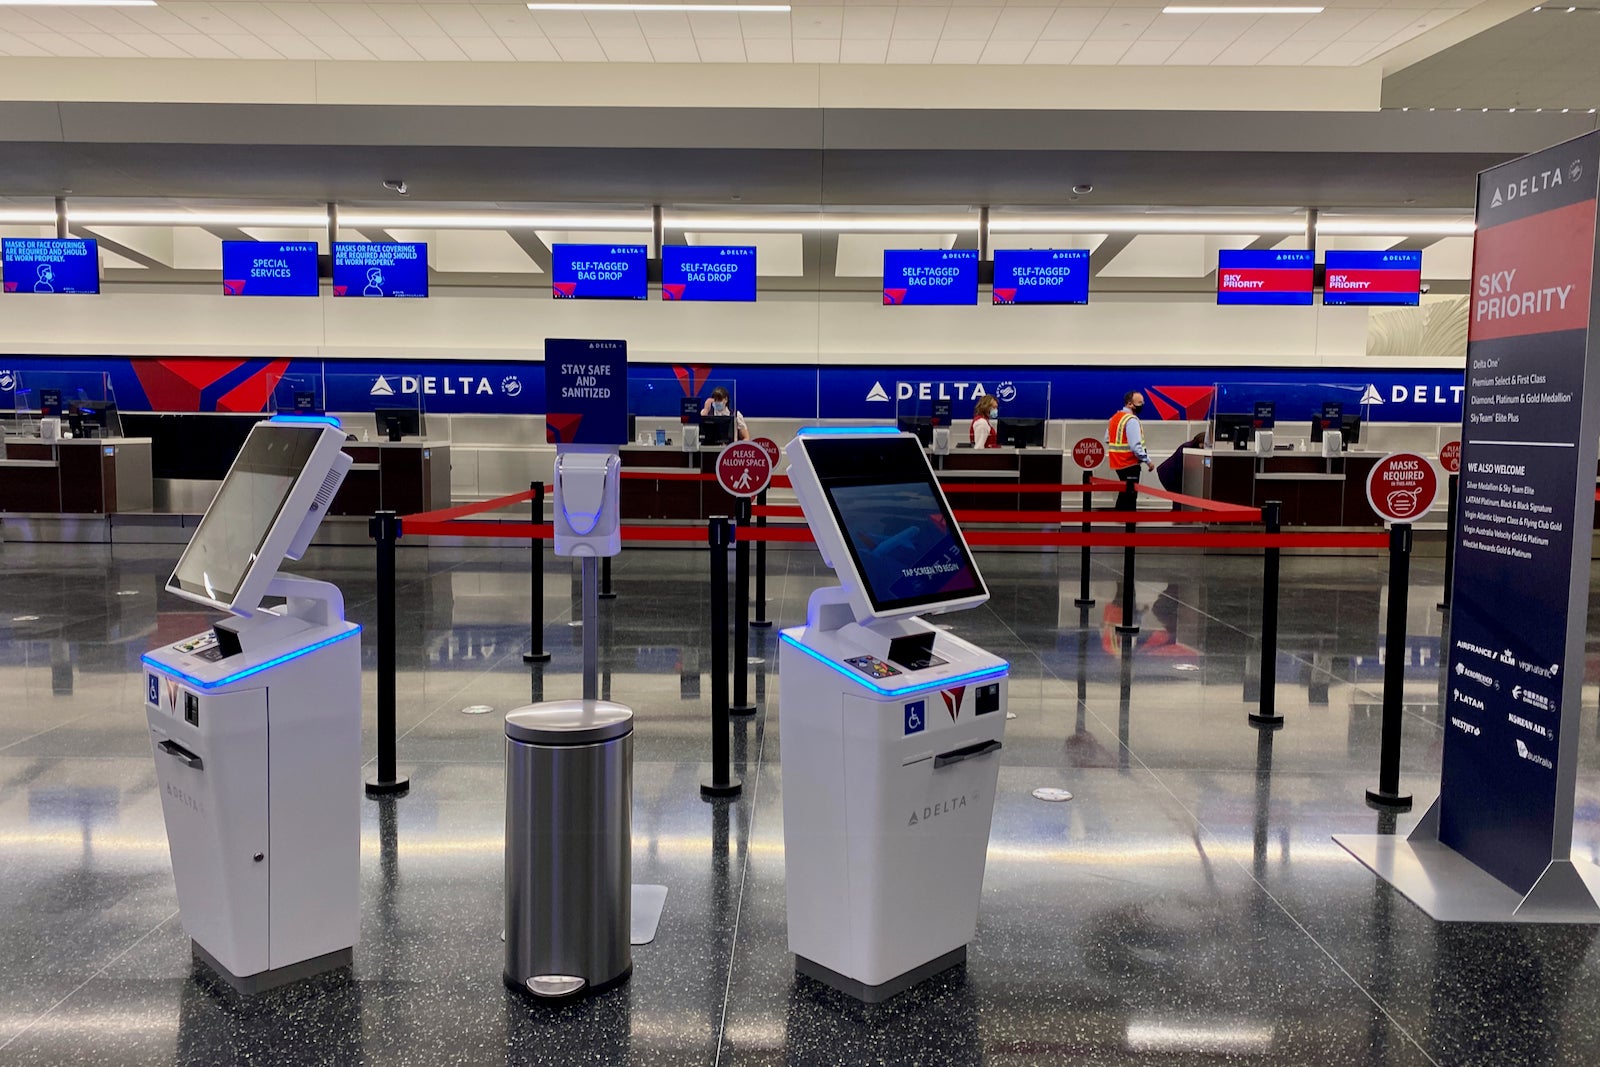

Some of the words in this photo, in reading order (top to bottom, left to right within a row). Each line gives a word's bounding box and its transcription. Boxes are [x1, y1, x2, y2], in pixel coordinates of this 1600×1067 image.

[1507, 168, 1562, 200] DELTA
[5, 241, 25, 249] MASKS
[27, 241, 36, 249] OR
[37, 241, 50, 249] FACE
[382, 245, 415, 253] COVERINGS
[19, 248, 48, 256] REQUIRED
[49, 248, 62, 256] AND
[253, 259, 288, 268] SPECIAL
[571, 261, 628, 271] SELF-TAGGED
[681, 263, 738, 272] SELF-TAGGED
[251, 269, 290, 277] SERVICES
[578, 272, 596, 280] BAG
[598, 272, 622, 280] DROP
[902, 267, 960, 276] SELF-TAGGED
[1012, 267, 1070, 276] SELF-TAGGED
[688, 273, 706, 282] BAG
[708, 273, 732, 282] DROP
[909, 277, 927, 286] BAG
[928, 277, 954, 286] DROP
[1019, 277, 1037, 286] BAG
[1038, 277, 1064, 286] DROP
[1478, 268, 1516, 297] SKY
[1223, 280, 1264, 288] PRIORITY
[1329, 281, 1370, 289] PRIORITY
[1477, 285, 1572, 321] PRIORITY
[1473, 359, 1486, 369] Delta
[561, 364, 586, 375] STAY
[588, 364, 611, 376] SAFE
[401, 377, 493, 394] DELTA
[576, 376, 596, 386] AND
[1472, 377, 1494, 387] Premium
[1495, 375, 1511, 386] Select
[1511, 375, 1516, 385] &
[1517, 374, 1530, 384] First
[1530, 374, 1546, 384] Class
[562, 387, 611, 398] SANITIZED
[898, 382, 987, 400] DELTA
[1391, 385, 1465, 403] DELT
[1471, 395, 1495, 405] Diamond,
[1496, 394, 1520, 404] Platinum
[1520, 393, 1525, 403] &
[1526, 393, 1540, 403] Gold
[1495, 413, 1507, 422] Elite
[1507, 413, 1520, 423] Plus
[733, 450, 756, 458] PLEASE
[722, 459, 745, 467] ALLOW
[746, 459, 766, 467] SPACE
[1390, 461, 1418, 470] MASKS
[1467, 463, 1478, 472] WE
[1478, 463, 1494, 474] ALSO
[1494, 464, 1525, 476] WELCOME
[1383, 471, 1424, 480] REQUIRED
[1478, 481, 1499, 491] Medallion
[1524, 486, 1535, 495] Elite
[1465, 496, 1481, 504] LATAM
[1500, 499, 1512, 508] Black
[1517, 501, 1529, 510] Black
[1530, 503, 1552, 513] Signature
[1465, 510, 1476, 520] Virgin
[1476, 512, 1492, 521] Atlantic
[1493, 514, 1506, 523] Upper
[1507, 515, 1519, 525] Class
[1519, 517, 1523, 526] &
[1524, 518, 1537, 529] Flying
[1538, 520, 1549, 530] Club
[1550, 521, 1562, 531] Gold
[1464, 524, 1475, 534] Virgin
[1475, 526, 1494, 537] Australia
[1494, 529, 1511, 541] Velocity
[1511, 532, 1523, 541] Gold
[1523, 534, 1527, 542] &
[1528, 534, 1549, 546] Platinum
[1463, 539, 1478, 549] WestJet
[1479, 541, 1496, 552] Rewards
[1496, 545, 1507, 555] Gold
[1507, 547, 1511, 555] &
[1511, 547, 1532, 559] Platinum
[902, 568, 913, 577] TAP
[913, 566, 933, 576] SCREEN
[933, 564, 943, 574] TO
[942, 563, 959, 572] BEGIN
[1500, 654, 1516, 666] KLM
[1459, 693, 1484, 710] LATAM
[1451, 716, 1475, 733] WESTJET
[1533, 723, 1546, 736] AIR
[1527, 751, 1552, 770] australia
[923, 795, 967, 820] DELTA
